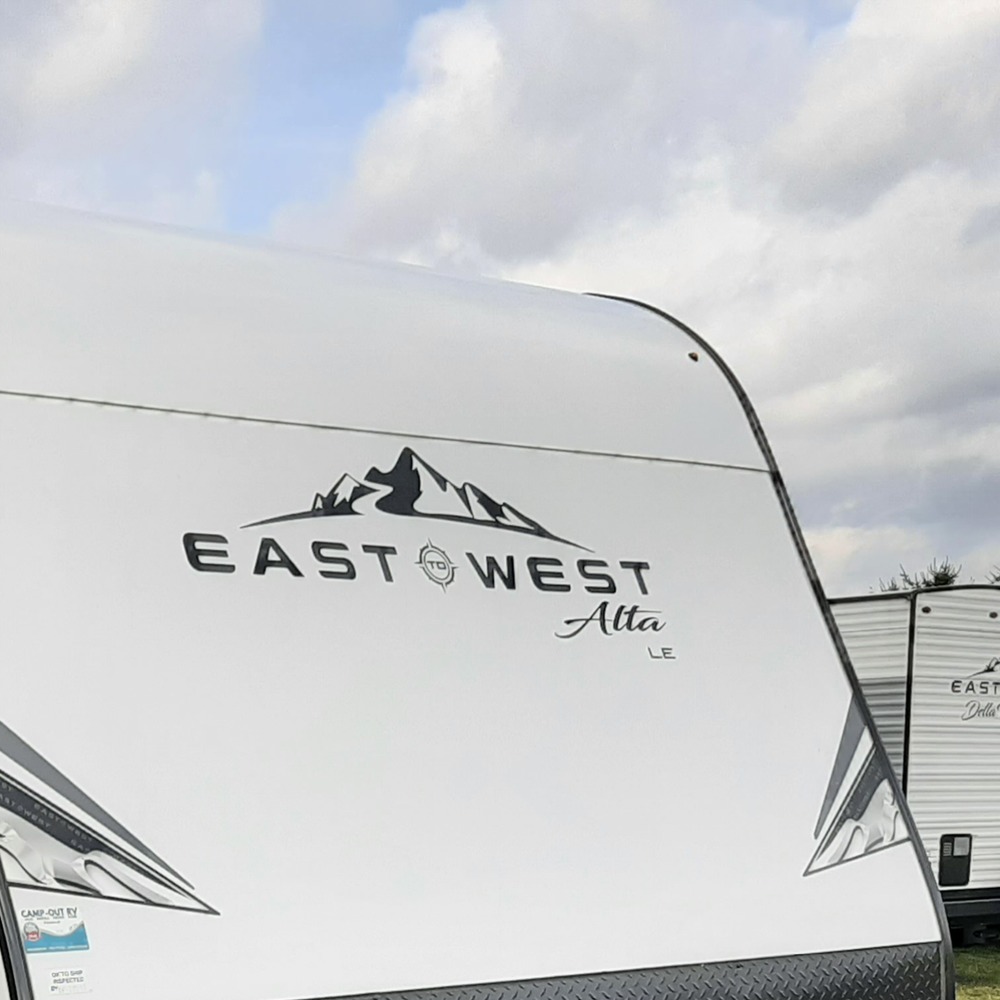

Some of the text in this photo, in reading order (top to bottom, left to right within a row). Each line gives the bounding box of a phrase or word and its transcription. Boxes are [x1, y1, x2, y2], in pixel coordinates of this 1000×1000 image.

[183, 532, 650, 595] EAST TO WEST
[554, 600, 667, 639] Alta
[648, 646, 677, 660] LE
[951, 680, 1000, 695] EAST
